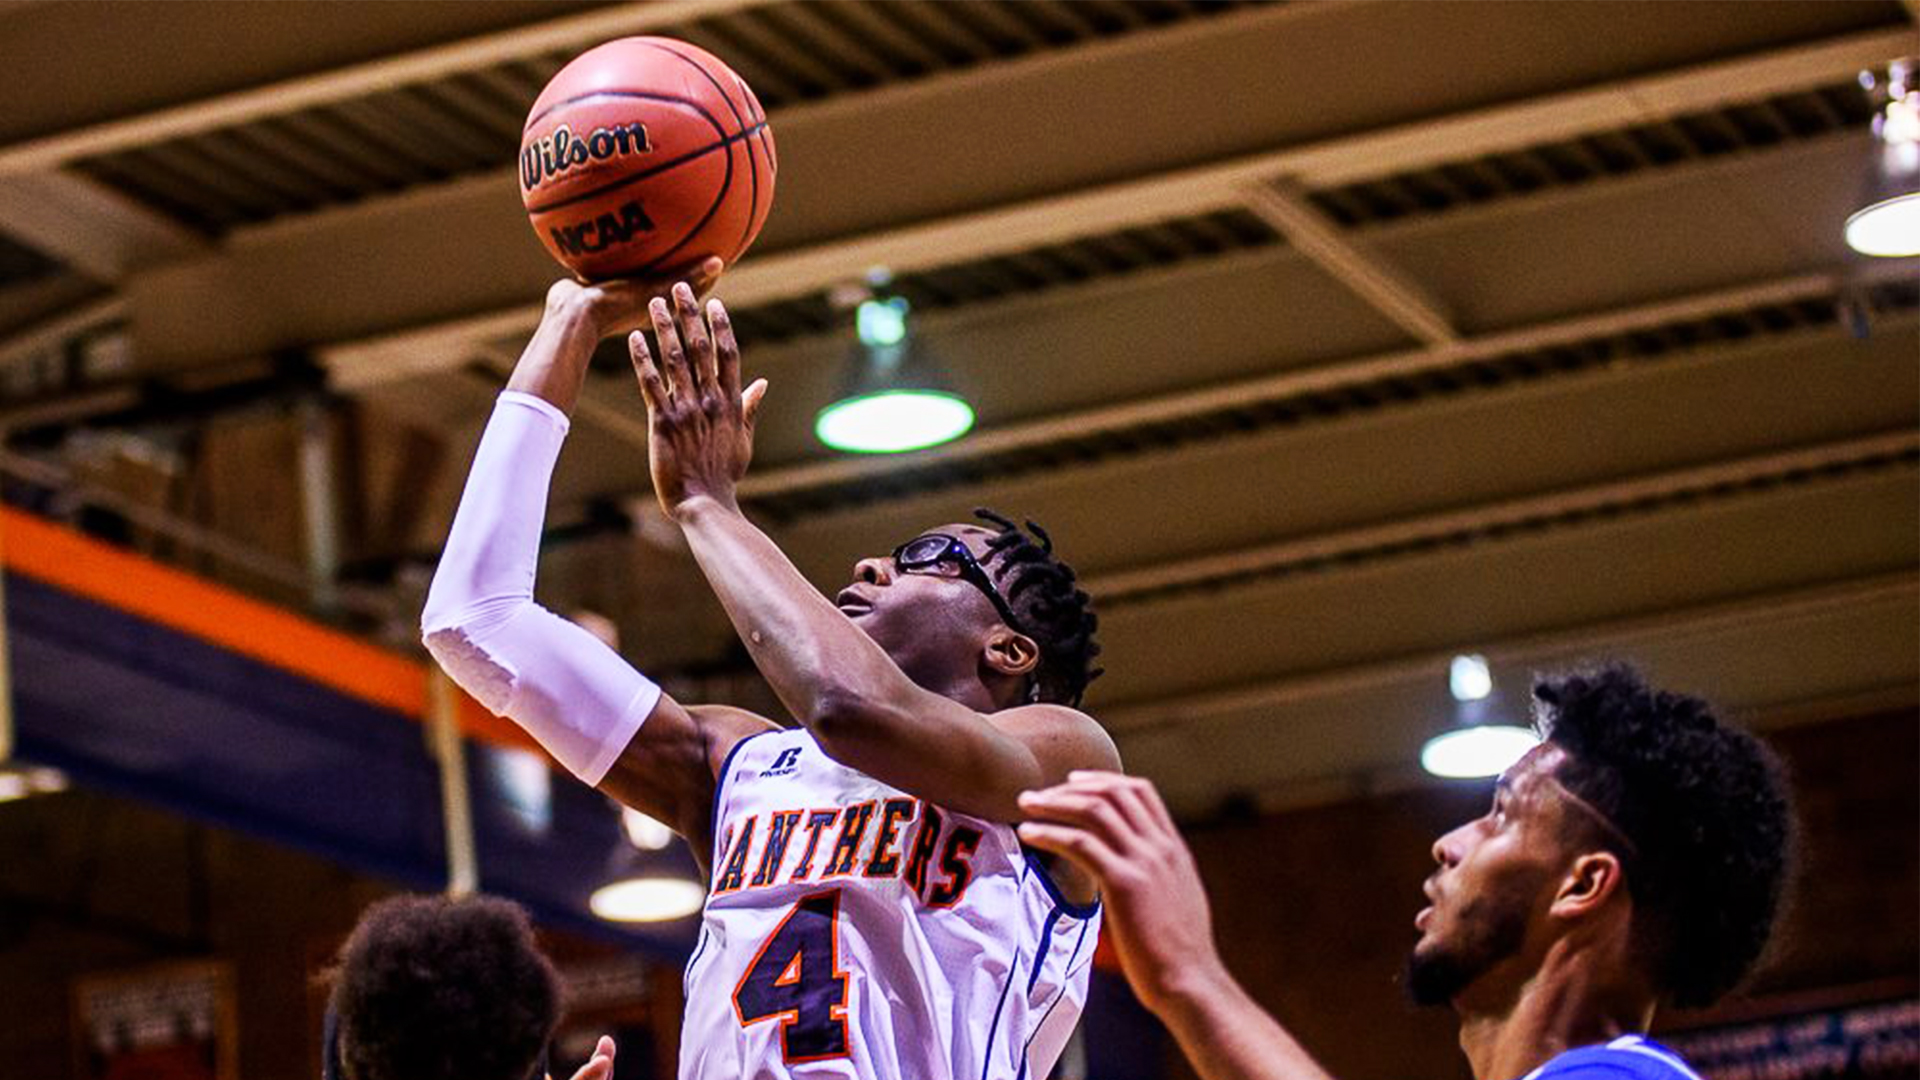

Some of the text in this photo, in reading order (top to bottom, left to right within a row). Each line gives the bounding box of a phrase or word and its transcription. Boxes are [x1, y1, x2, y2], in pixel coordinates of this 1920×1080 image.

[520, 123, 652, 191] Wilson
[550, 202, 655, 256] NCAA
[731, 887, 851, 1064] 4
